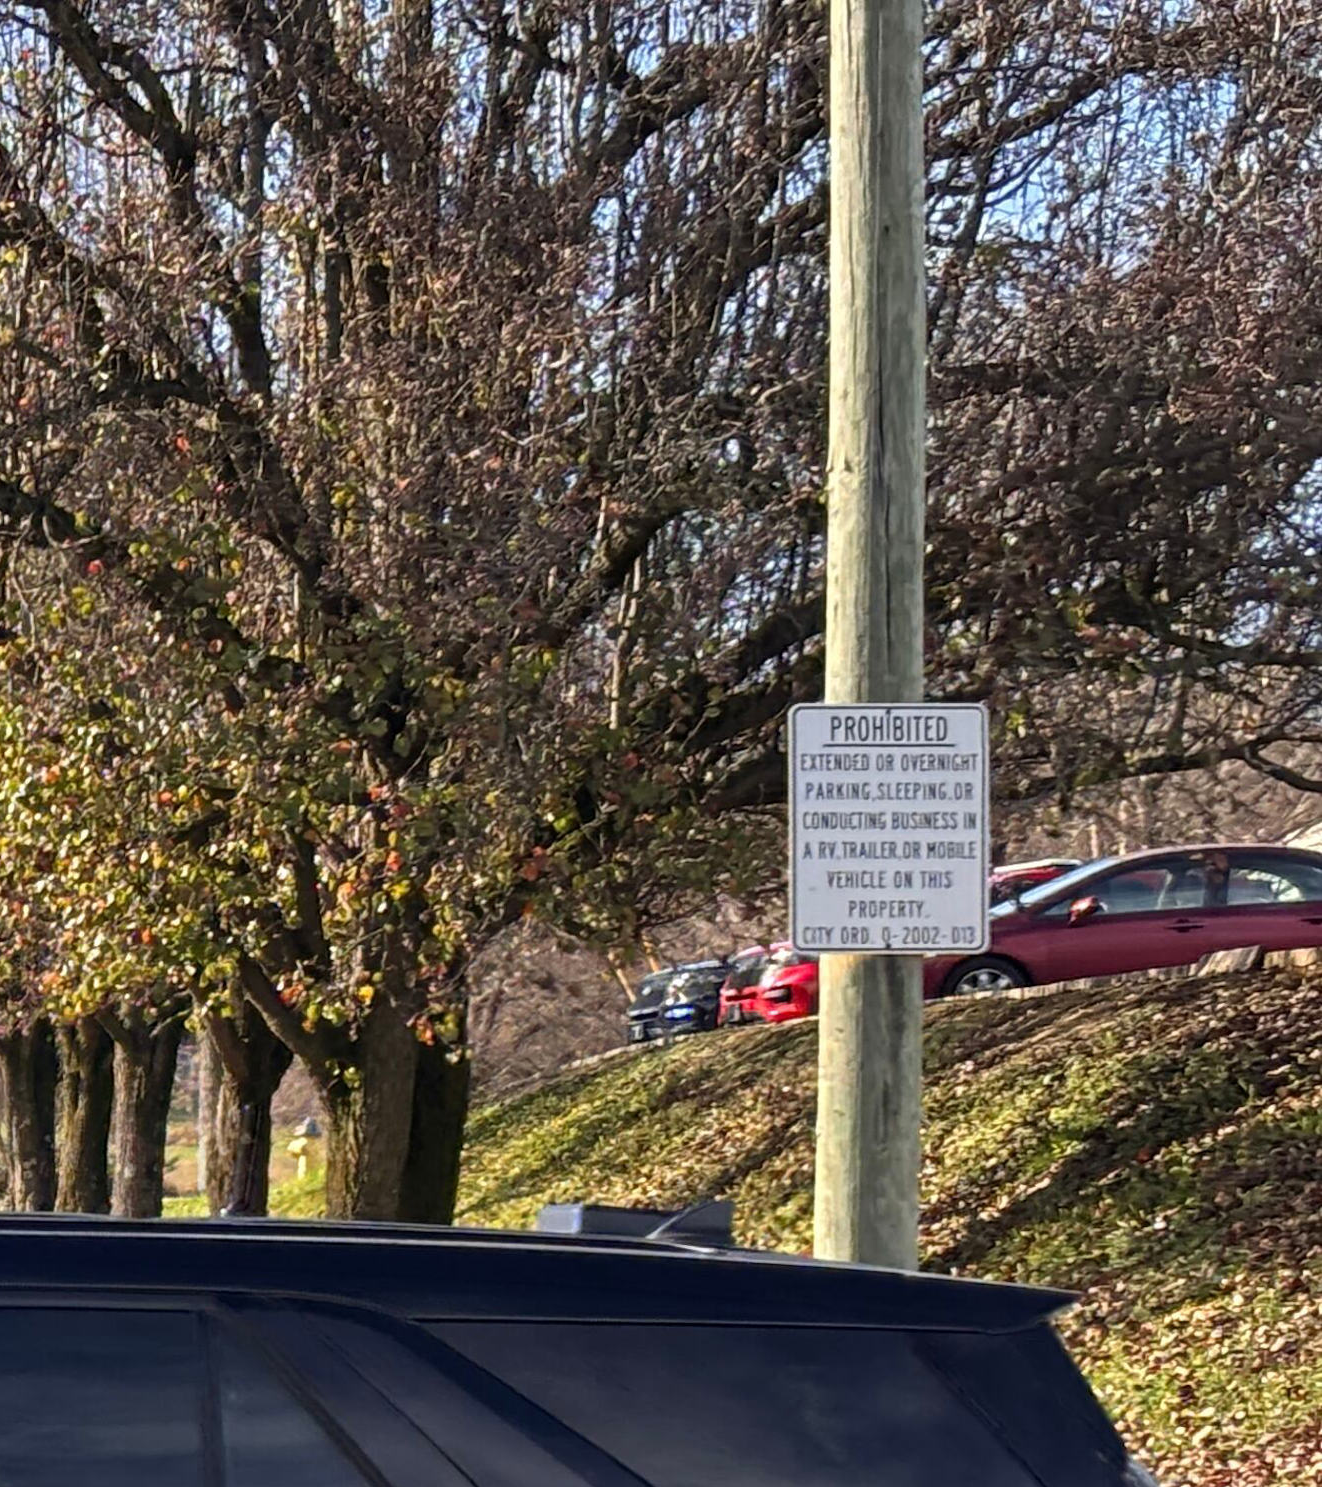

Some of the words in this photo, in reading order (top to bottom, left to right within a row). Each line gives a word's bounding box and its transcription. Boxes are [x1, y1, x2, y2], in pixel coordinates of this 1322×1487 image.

[830, 715, 949, 742] PROHIBITED
[800, 753, 870, 772] EXTENDED
[876, 753, 895, 772] OR
[900, 753, 979, 772] OVERNIGHT
[802, 811, 887, 830] CONDUCTING
[891, 811, 958, 830] BUSINESS
[964, 811, 977, 830] IN
[802, 841, 813, 860] A
[926, 841, 978, 860] MOBILE
[827, 870, 887, 889] VEHICLE
[893, 870, 914, 889] ON
[920, 870, 954, 889] THIS
[803, 926, 835, 945] CITY
